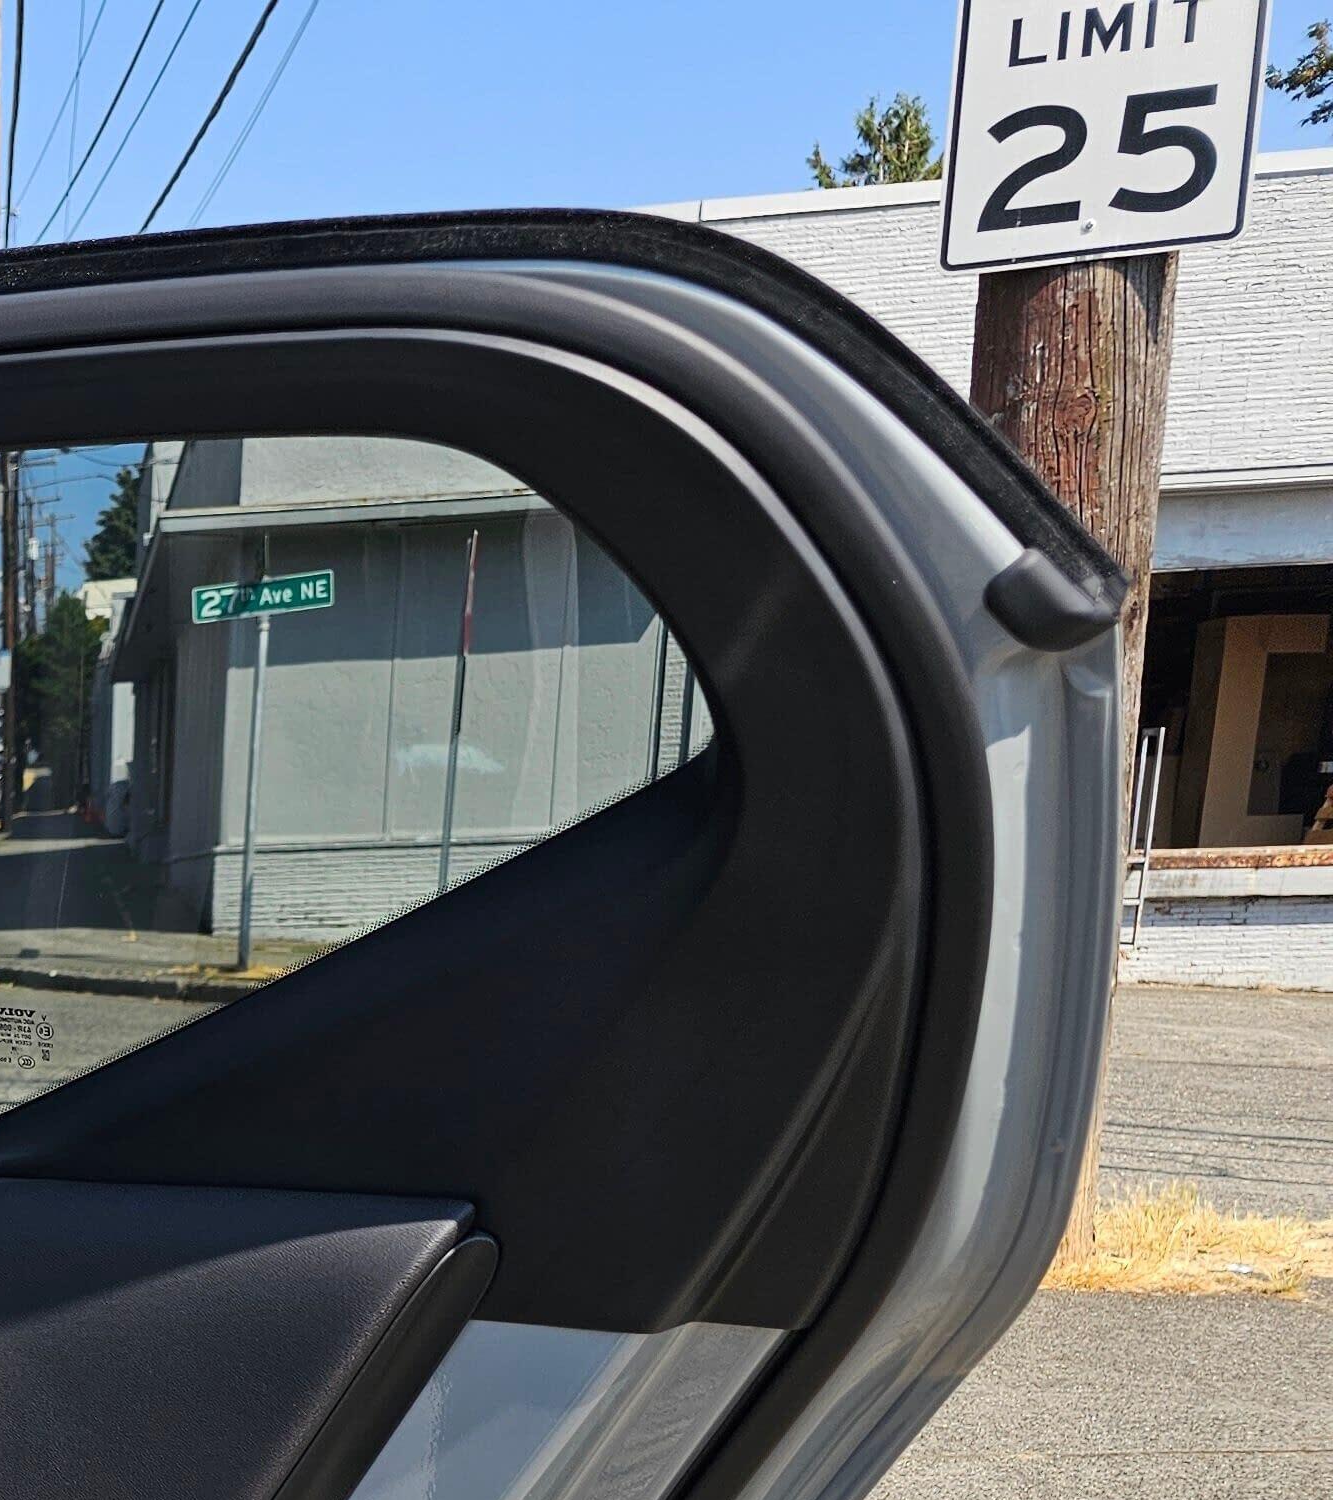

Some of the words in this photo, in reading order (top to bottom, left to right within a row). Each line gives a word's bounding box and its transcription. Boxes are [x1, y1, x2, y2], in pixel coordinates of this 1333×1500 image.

[1008, 0, 1201, 67] LIMIT
[977, 83, 1219, 233] 25
[259, 587, 294, 606] Ave
[300, 579, 329, 601] NE
